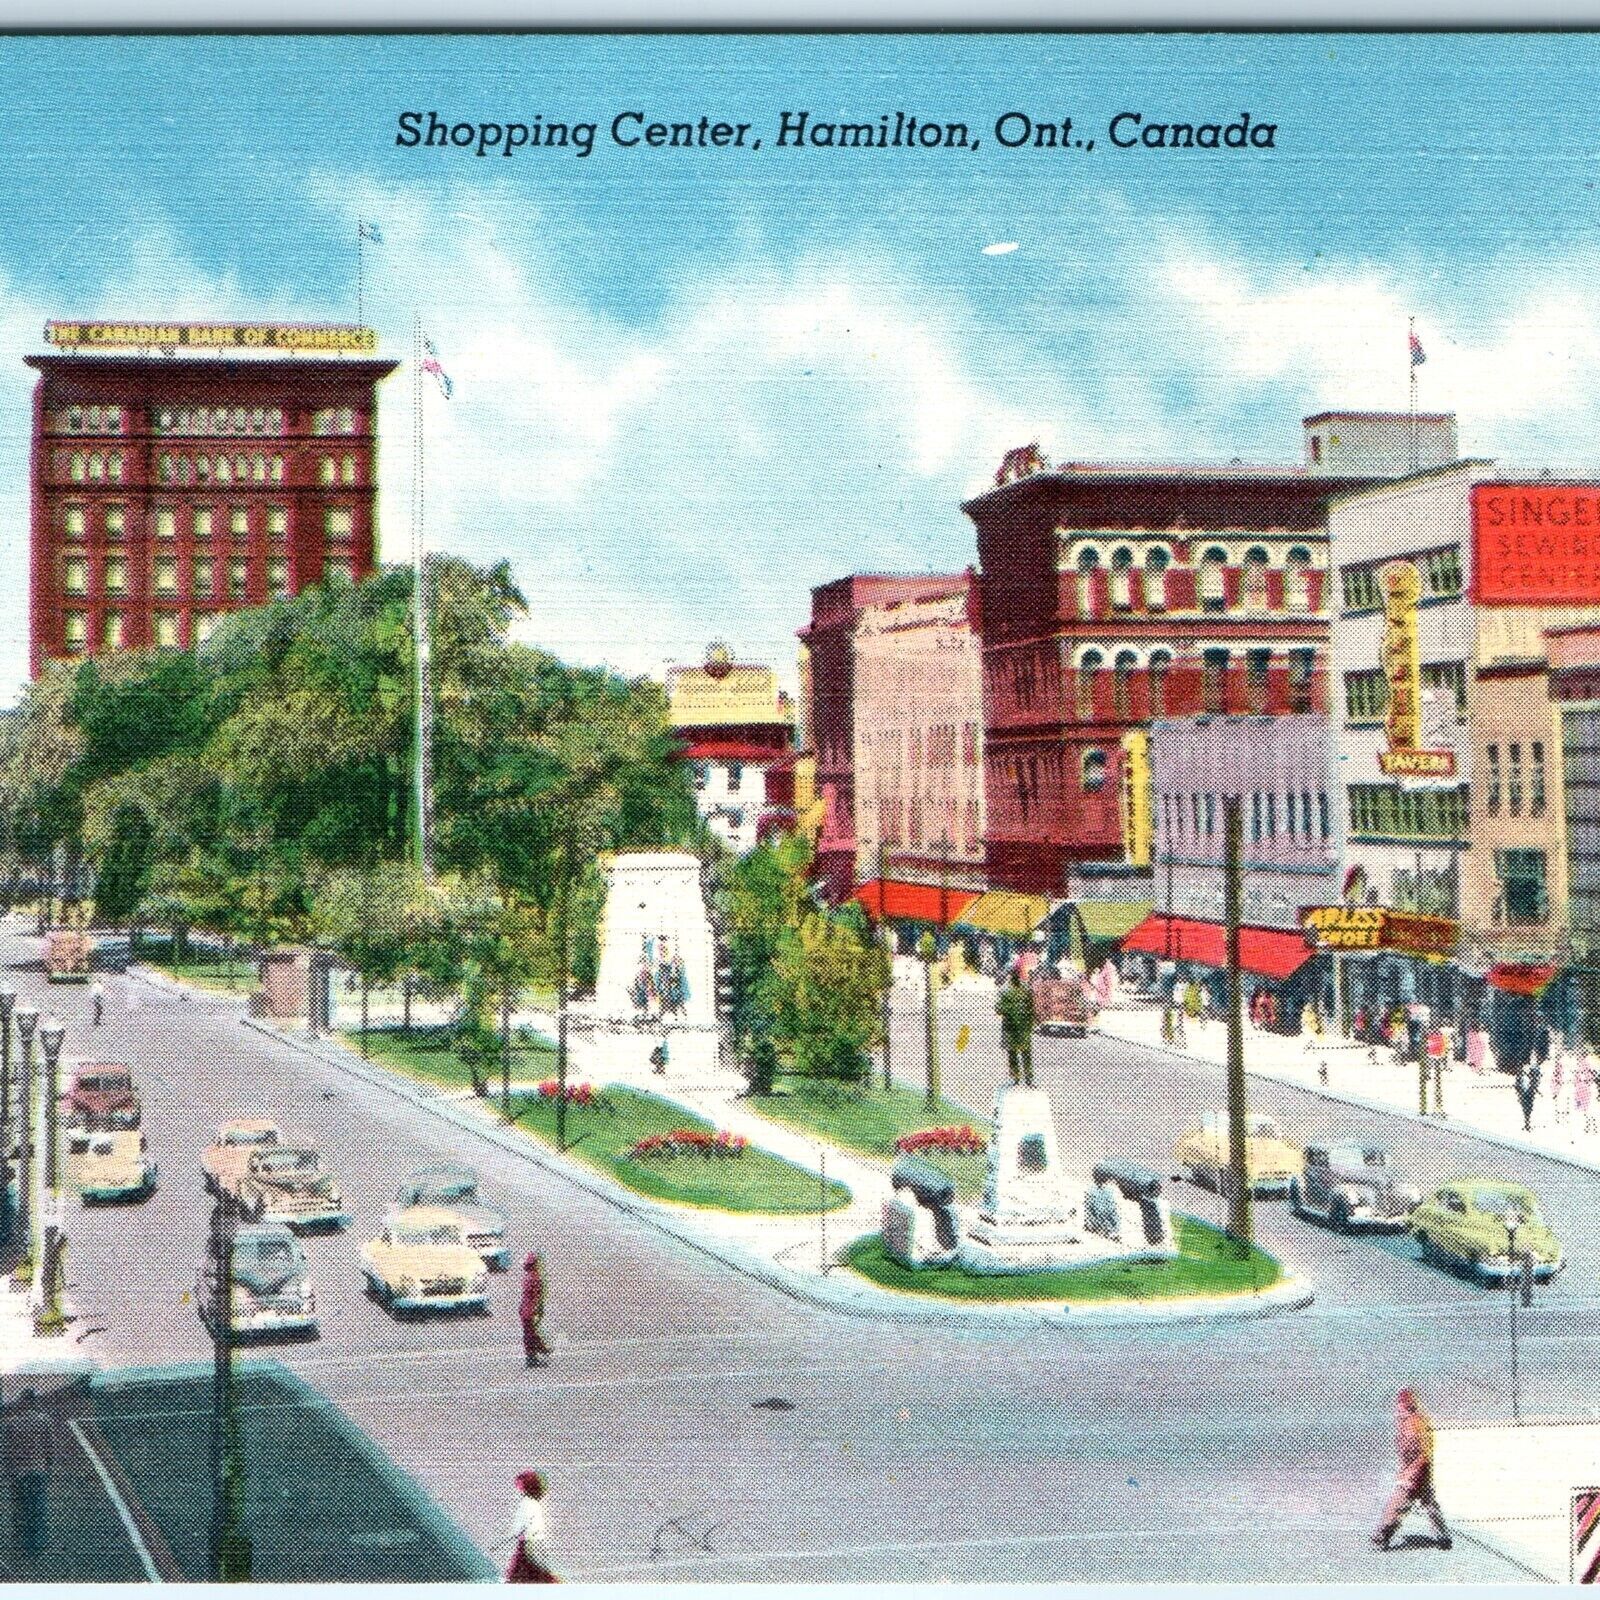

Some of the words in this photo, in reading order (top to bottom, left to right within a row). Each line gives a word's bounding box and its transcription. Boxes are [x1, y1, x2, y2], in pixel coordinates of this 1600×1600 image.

[88, 325, 180, 343] CANADIAN
[243, 327, 266, 346] OF
[274, 327, 376, 349] COMMERCE
[1487, 497, 1600, 527] SINGE
